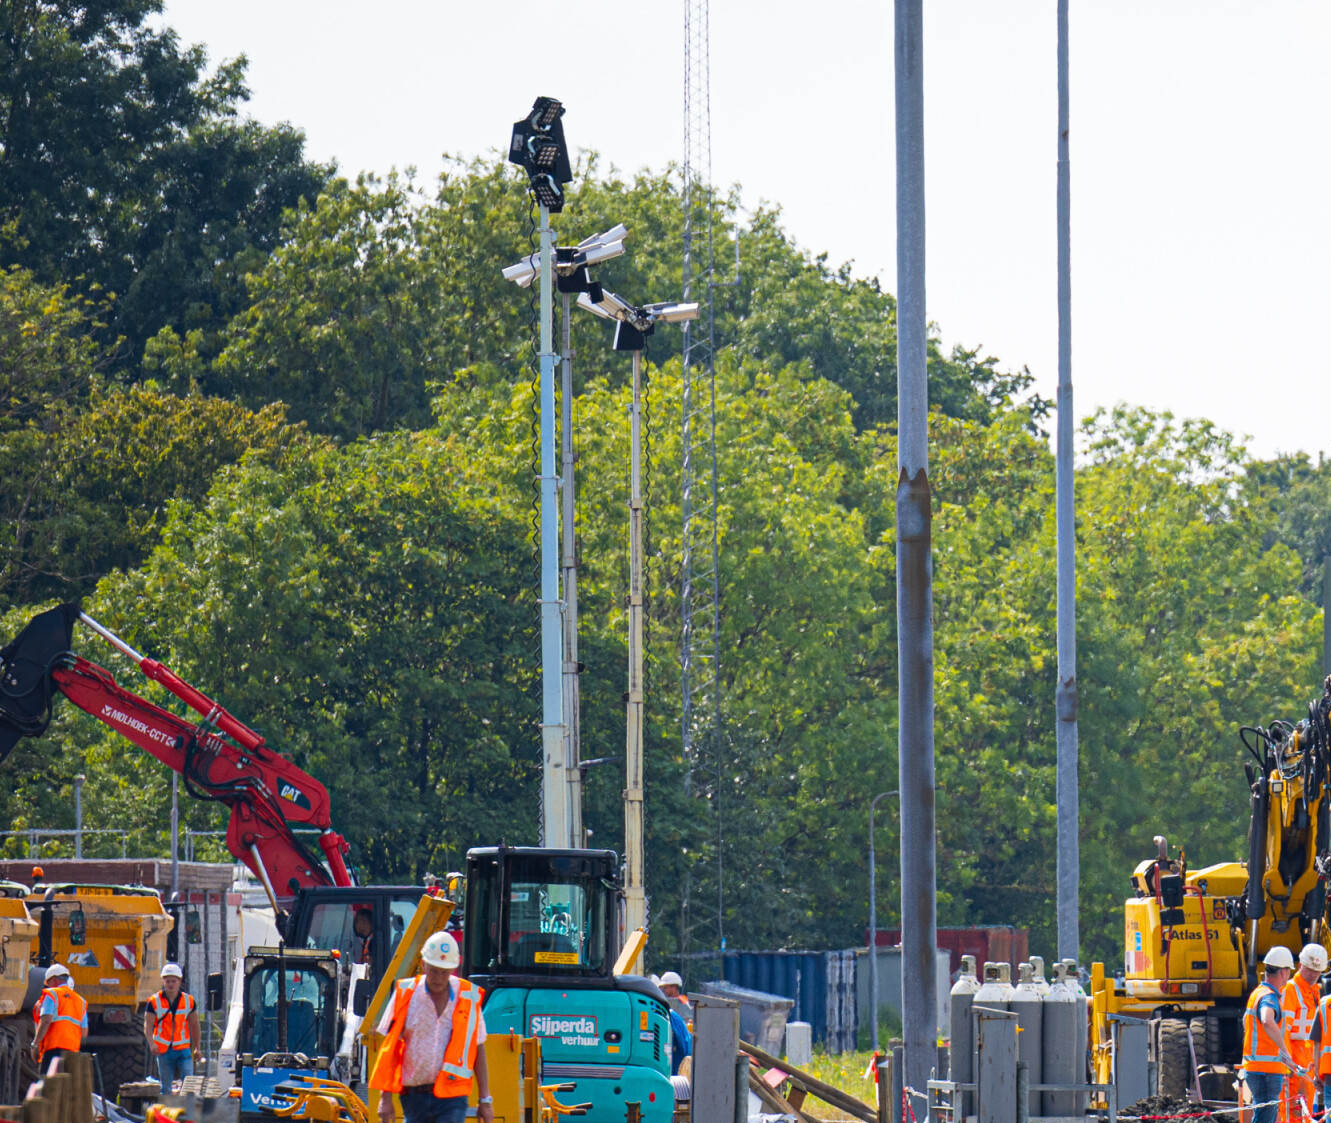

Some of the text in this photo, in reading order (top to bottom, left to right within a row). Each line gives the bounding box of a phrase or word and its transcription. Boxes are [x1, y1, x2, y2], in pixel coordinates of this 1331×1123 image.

[111, 709, 168, 743] MOLHOEK-CCT
[281, 785, 301, 802] CAT
[1172, 929, 1202, 940] Atlas
[532, 1017, 594, 1036] Sijperda
[561, 1035, 600, 1046] verhuur
